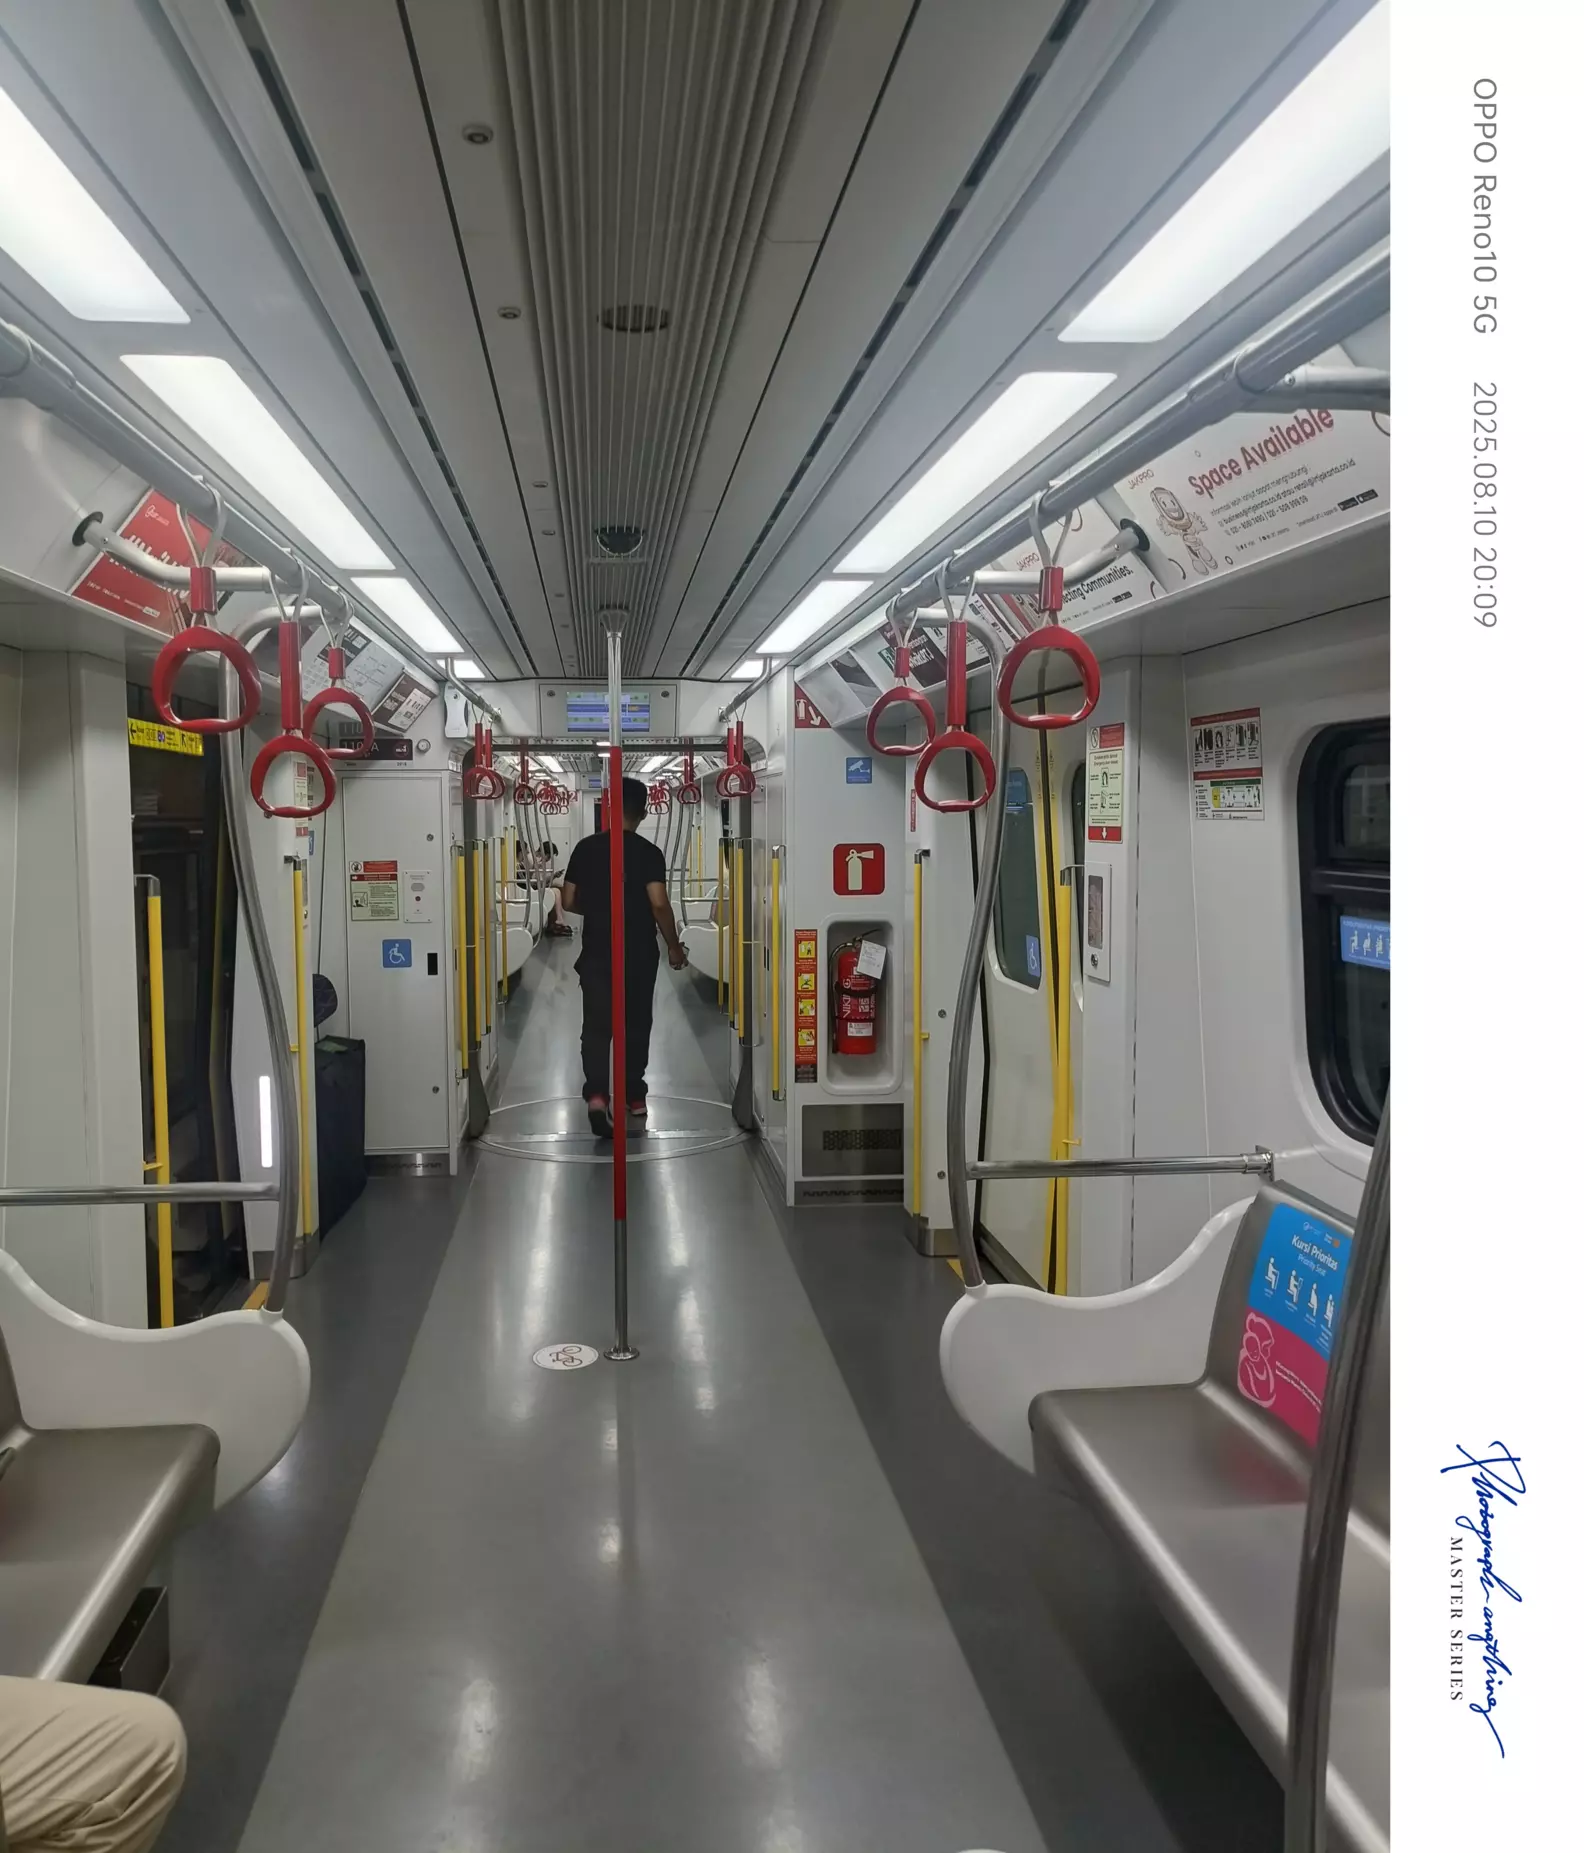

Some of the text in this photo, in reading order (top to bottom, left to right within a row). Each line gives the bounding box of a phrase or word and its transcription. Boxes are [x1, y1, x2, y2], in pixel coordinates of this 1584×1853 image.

[1188, 408, 1335, 499] Space Available
[1128, 469, 1155, 490] JAKPRO
[1016, 552, 1041, 571] JAKPRO
[842, 978, 851, 1019] VIKIG
[1291, 1234, 1312, 1254] Kursi
[1311, 1244, 1339, 1271] Prioritas
